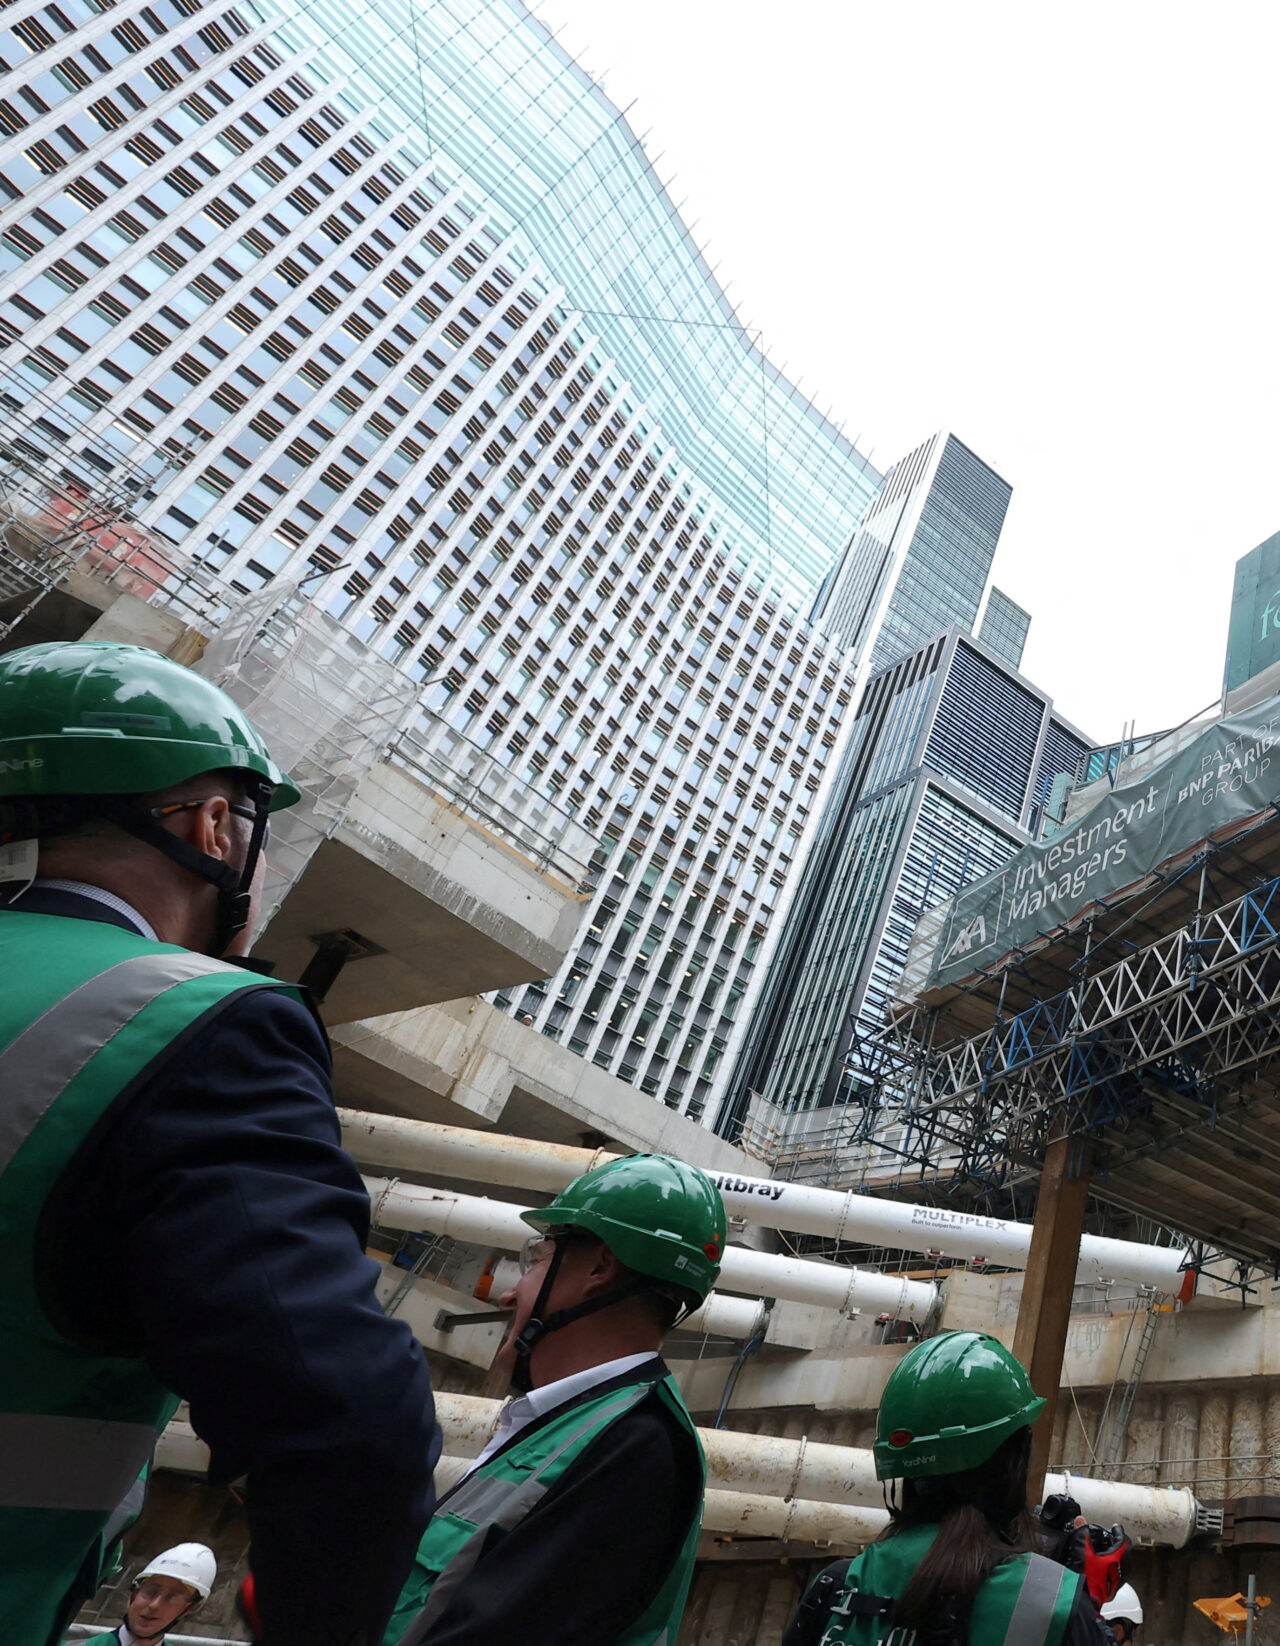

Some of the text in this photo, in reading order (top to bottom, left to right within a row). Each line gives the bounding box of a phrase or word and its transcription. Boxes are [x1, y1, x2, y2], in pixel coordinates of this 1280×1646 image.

[1201, 715, 1280, 772] PART OF
[1177, 770, 1214, 805] BNP
[1201, 757, 1271, 807] GROUP
[1013, 786, 1160, 893] Investment
[1007, 838, 1128, 928] Managers
[913, 1208, 1008, 1231] MULTIPLEX
